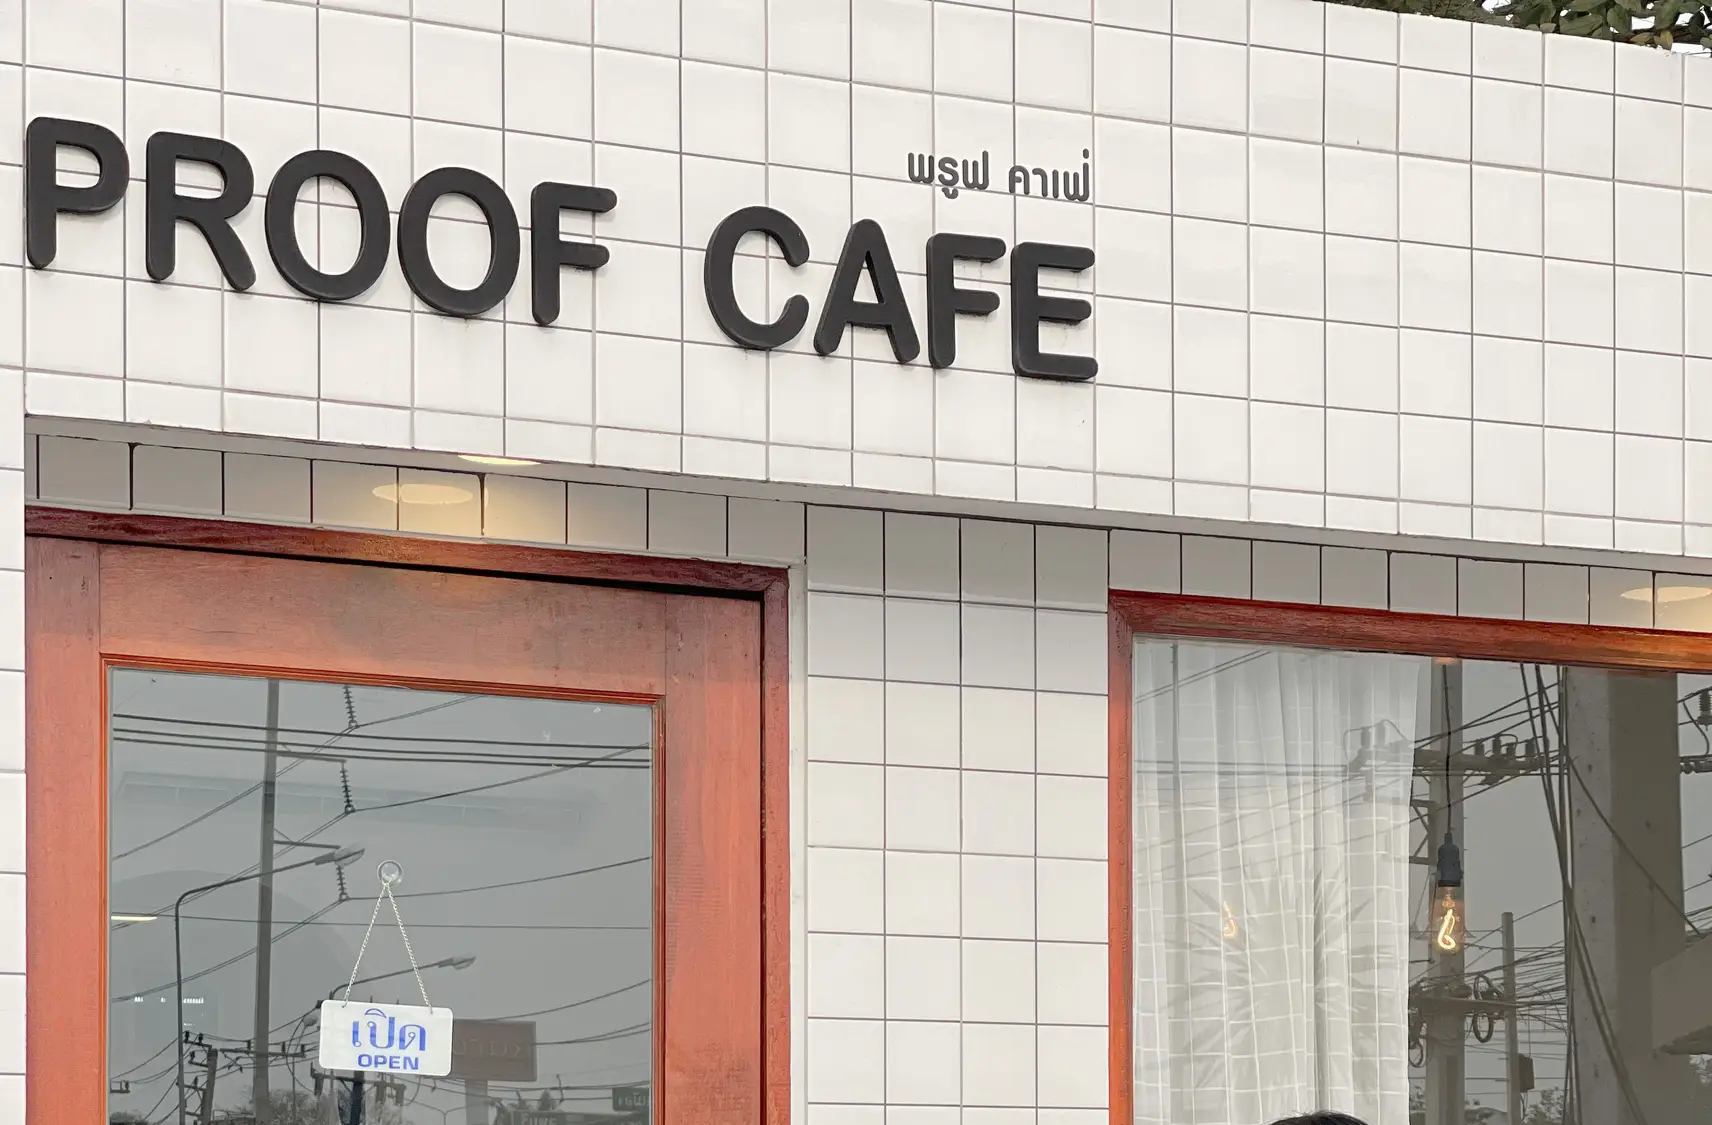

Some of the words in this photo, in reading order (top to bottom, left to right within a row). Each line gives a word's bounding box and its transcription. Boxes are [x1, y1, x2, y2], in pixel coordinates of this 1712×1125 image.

[907, 150, 990, 199] พรูฟ
[1008, 148, 1090, 202] คาเฟ่
[26, 116, 617, 327] PROOF
[704, 206, 1098, 381] CAFE
[352, 1008, 426, 1051] เปิด
[357, 1053, 419, 1070] OPEN
